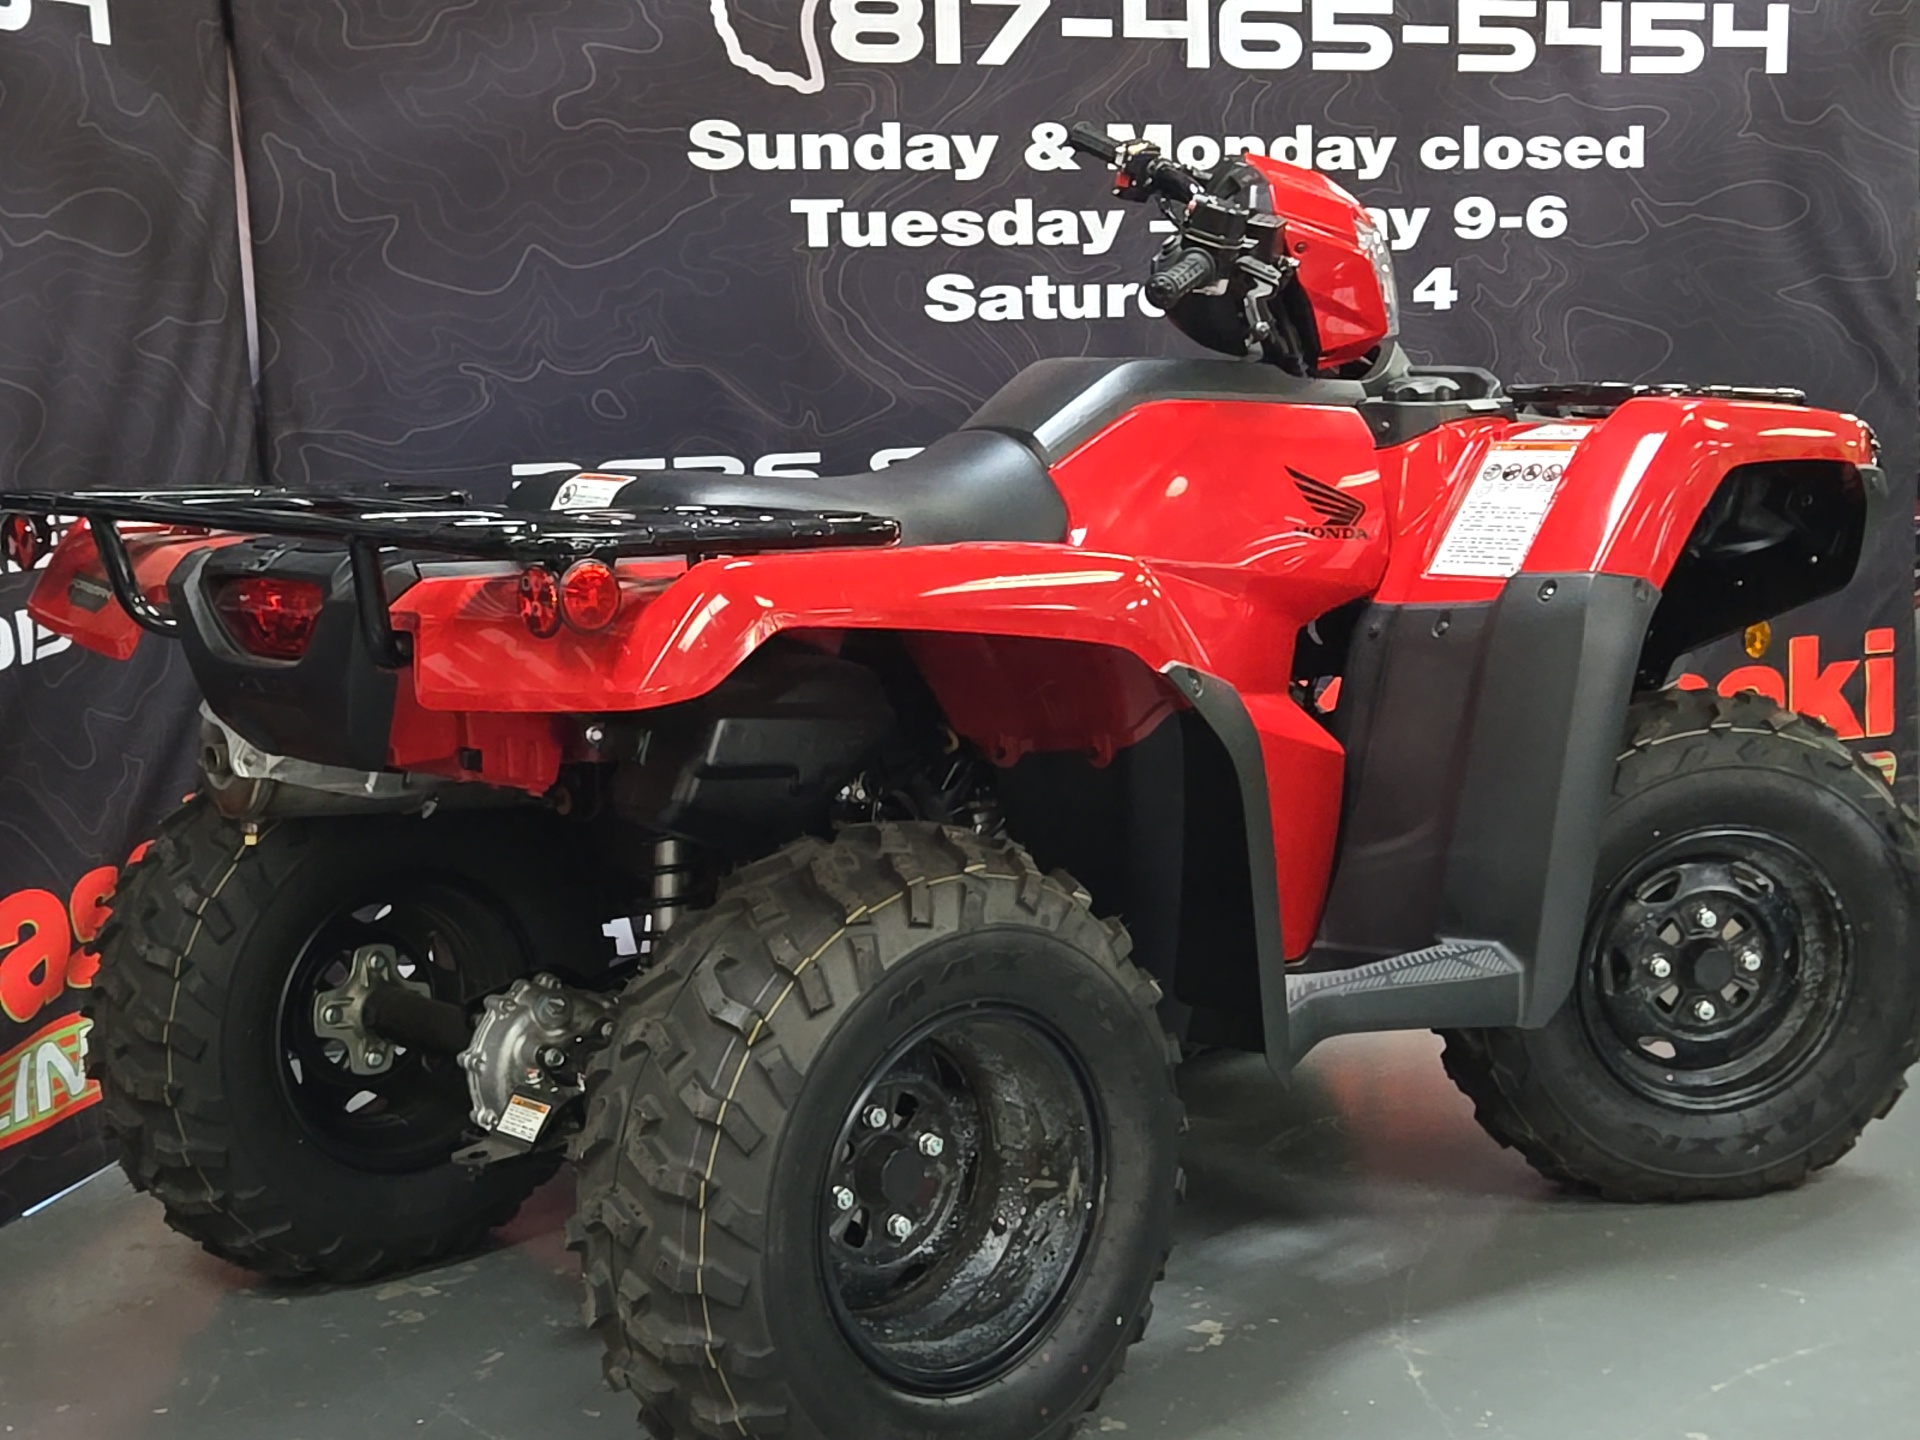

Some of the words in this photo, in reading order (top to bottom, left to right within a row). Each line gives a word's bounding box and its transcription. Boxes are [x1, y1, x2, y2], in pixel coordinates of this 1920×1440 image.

[830, 0, 1789, 74] 817-465-5454
[688, 119, 999, 181] Sunday
[1025, 123, 1081, 171] &
[1420, 125, 1645, 170] closed
[790, 198, 1126, 255] Tuesday
[1453, 195, 1569, 239] 9-6
[1412, 267, 1458, 310] 4
